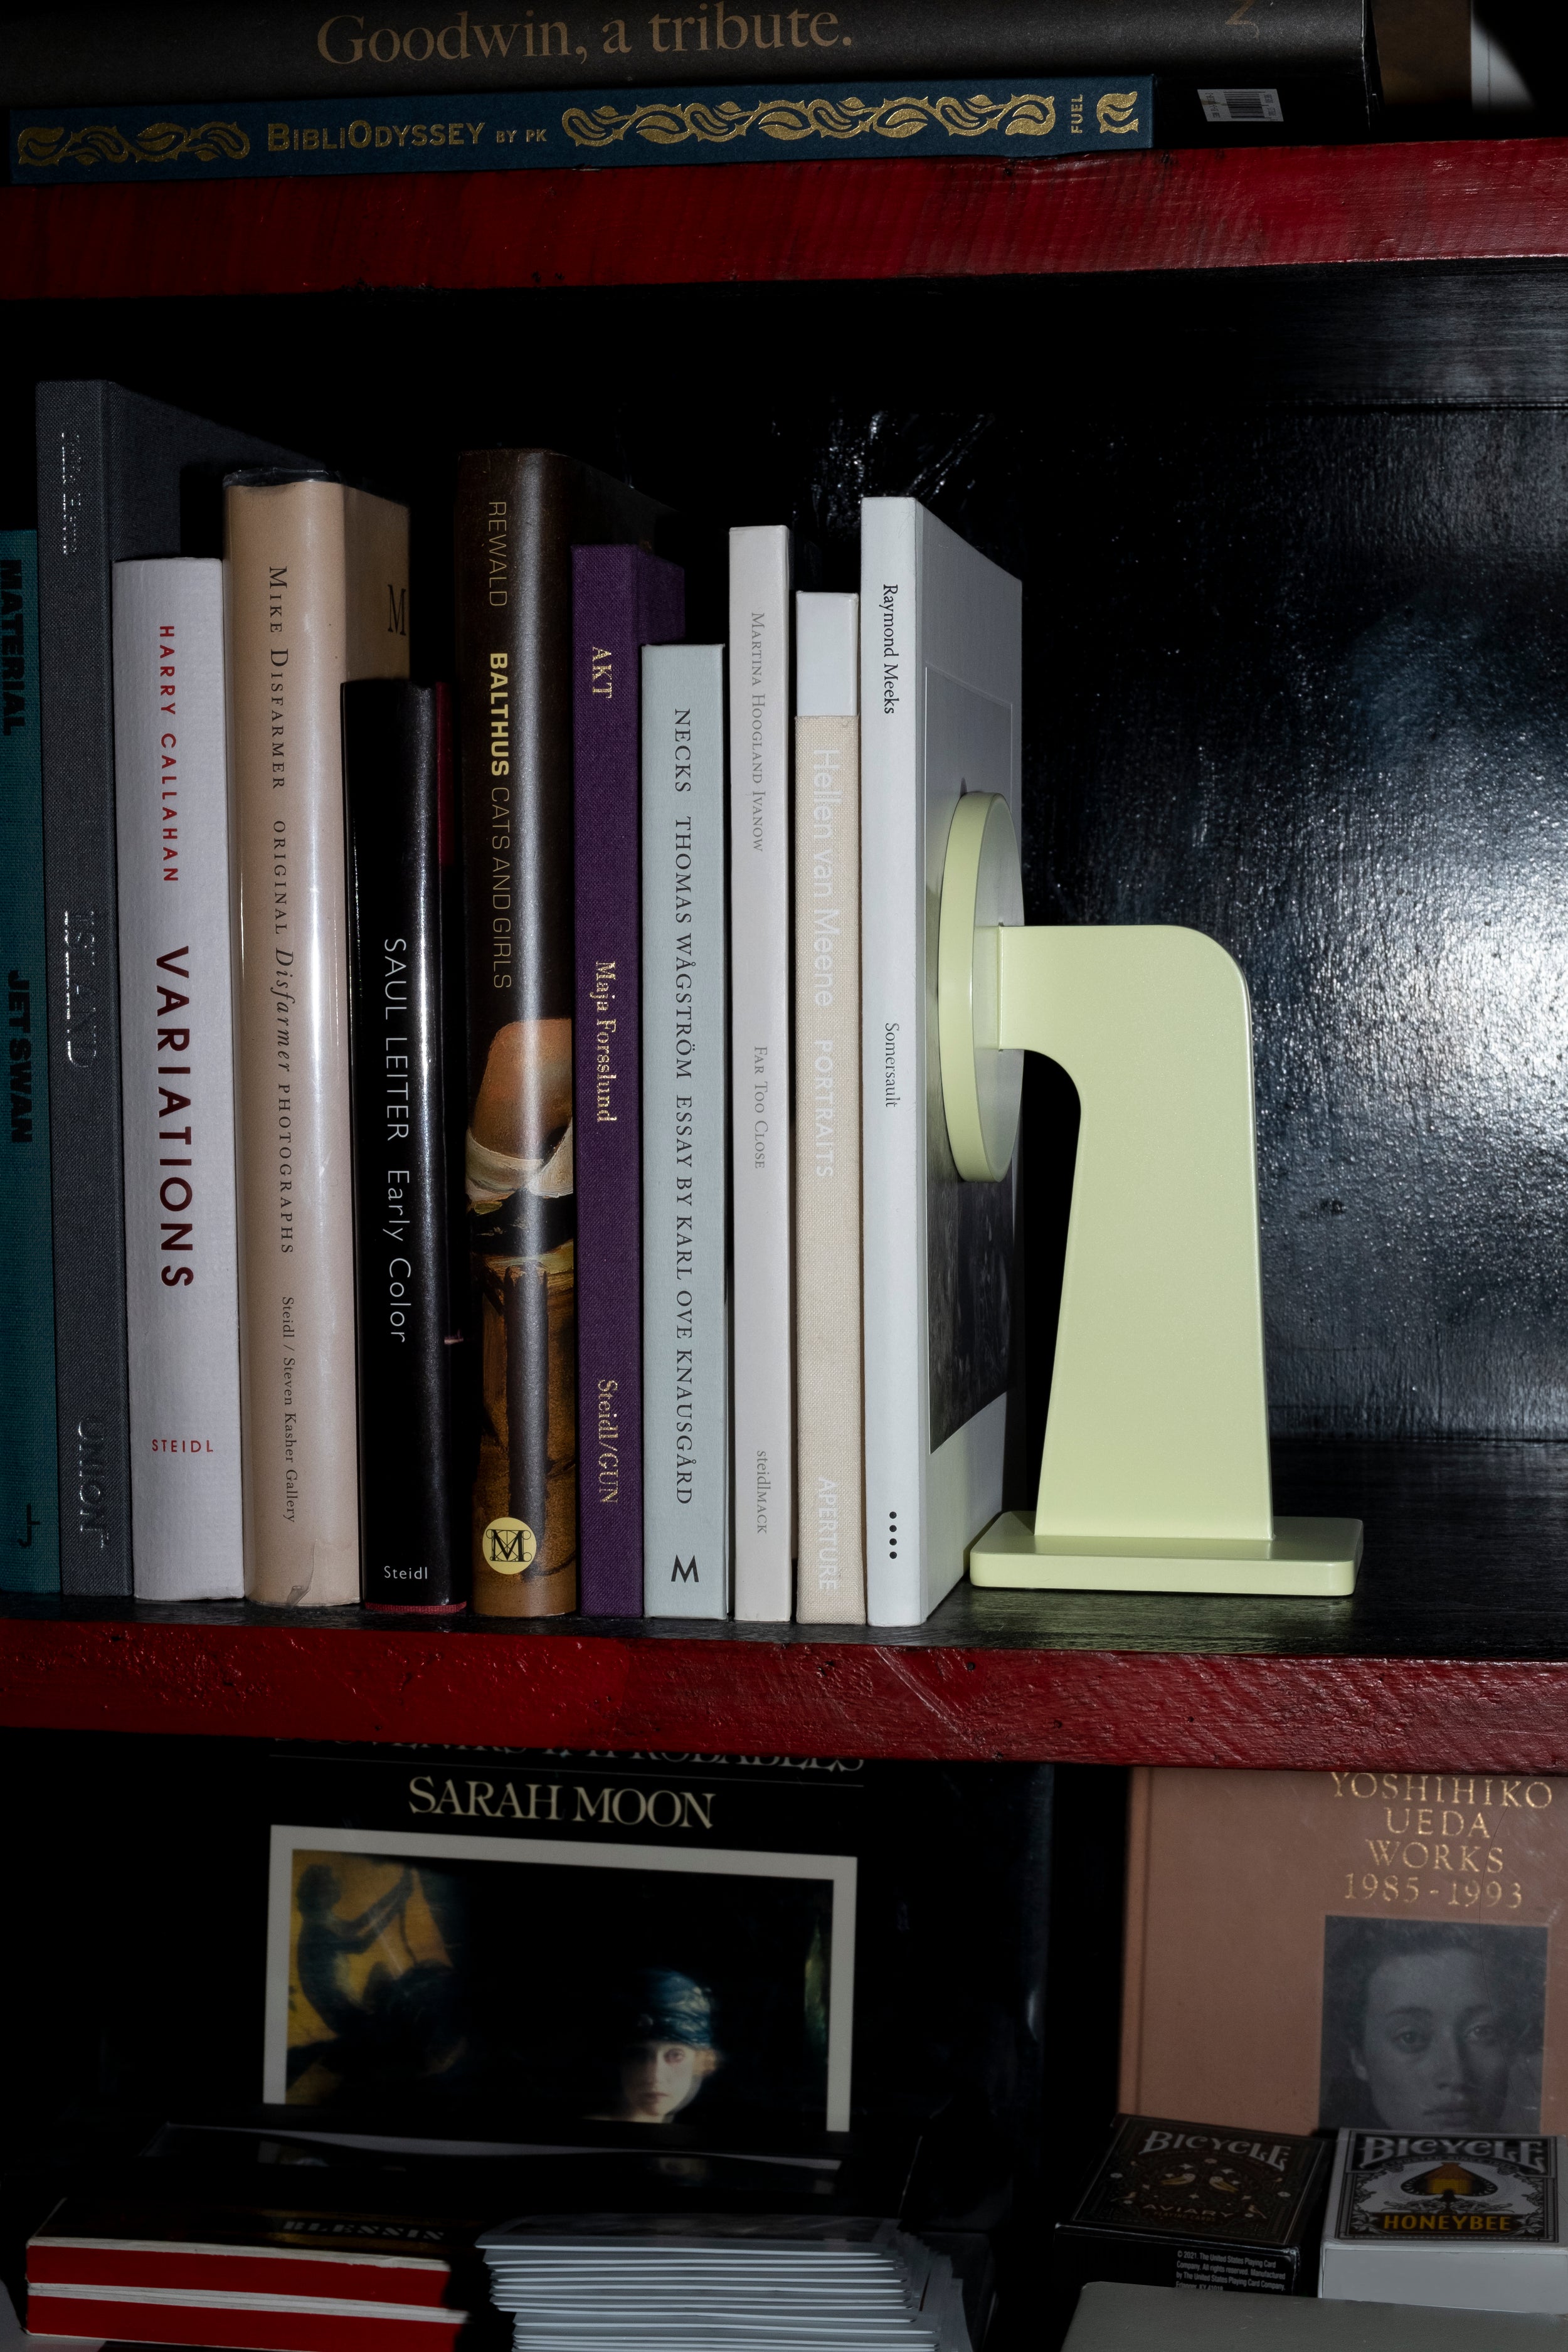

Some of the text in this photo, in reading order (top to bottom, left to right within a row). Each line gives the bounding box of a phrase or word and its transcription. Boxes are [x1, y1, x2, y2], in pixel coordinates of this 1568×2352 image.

[317, 1, 854, 66] Goodwin, a tribute.
[526, 129, 548, 143] PK
[1071, 93, 1083, 134] FUEL
[388, 583, 406, 636] M
[1, 559, 25, 735] MATERIAL
[592, 647, 612, 699] AKT
[879, 584, 899, 714] Raymond Meeks
[159, 626, 178, 881] HARRY CALLAHAN
[489, 501, 512, 988] REWALD BALTHUS CATS AND GIRLS
[273, 820, 287, 935] ORIGINAL
[813, 749, 840, 1177] Hellen van Meene PORTRAITS
[270, 948, 295, 1072] Disfarmer
[8, 970, 33, 1142] JET SWAN
[590, 961, 617, 1123] Maja Forsslund
[885, 1022, 901, 1108] Somersault
[156, 946, 194, 1286] VARIATIONS
[674, 709, 697, 1505] NECKS THOMAS WÅGSTRÖM ESSAY BY KARL OVE KNAUSGÅRD
[382, 938, 412, 1343] SAUL LEITER Early Color
[278, 1083, 294, 1253] PHOTOGRAPHS
[282, 1296, 295, 1338] Steidl
[283, 1357, 295, 1406] Steven
[152, 1439, 213, 1453] STEIDL
[284, 1412, 297, 1463] Kasher
[598, 1379, 618, 1503] Steidl/GUN
[283, 1469, 299, 1523] Gallery
[818, 1476, 838, 1590] APERTURE
[384, 1566, 428, 1580] Steidl
[671, 1555, 699, 1583] M
[406, 1775, 716, 1830] SARAH MOON
[1331, 1772, 1552, 1809] YOSHIHIKO
[1384, 1807, 1490, 1838] UEDA
[1365, 1840, 1503, 1873] WORKS
[1138, 2131, 1292, 2172] BICYCLE
[1359, 2136, 1546, 2174] BICYCLE
[1142, 2203, 1235, 2218] AVIARY
[1383, 2214, 1512, 2232] HONEYBEE
[1184, 2272, 1193, 2280] The
[1194, 2273, 1210, 2281] United
[1211, 2275, 1227, 2283] States
[1228, 2277, 1247, 2287] Playing
[1248, 2279, 1260, 2287] Card
[1200, 2252, 1209, 2260] The
[1210, 2254, 1226, 2262] United
[1227, 2255, 1244, 2264] States
[1244, 2257, 1263, 2268] Playing
[1264, 2260, 1276, 2268] Card
[1210, 2265, 1225, 2274] rights
[1251, 2269, 1286, 2280] Manufactured
